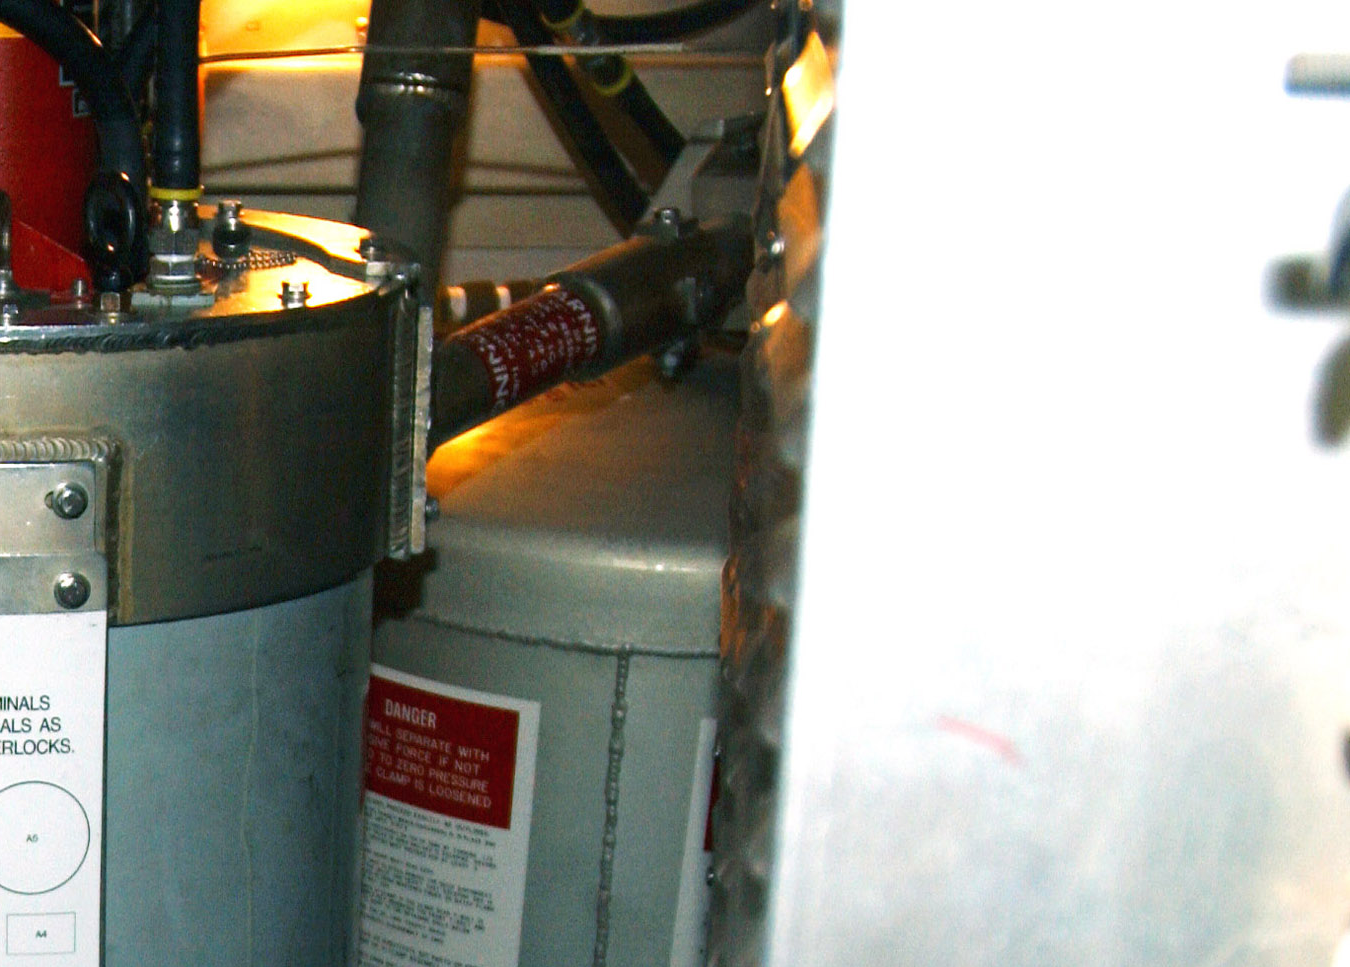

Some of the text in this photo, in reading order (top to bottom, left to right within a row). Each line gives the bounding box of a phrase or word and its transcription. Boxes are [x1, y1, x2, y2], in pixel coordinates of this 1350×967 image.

[39, 716, 62, 733] AS
[385, 698, 437, 729] DANGER
[395, 727, 452, 754] SEPARATE
[458, 745, 490, 763] WITH
[395, 742, 431, 764] FORCE
[439, 755, 450, 767] IF
[454, 759, 481, 777] NOT
[375, 765, 492, 809] CLAMP IS LOOSENED
[396, 758, 425, 777] ZERO
[429, 768, 490, 793] PRESSURE
